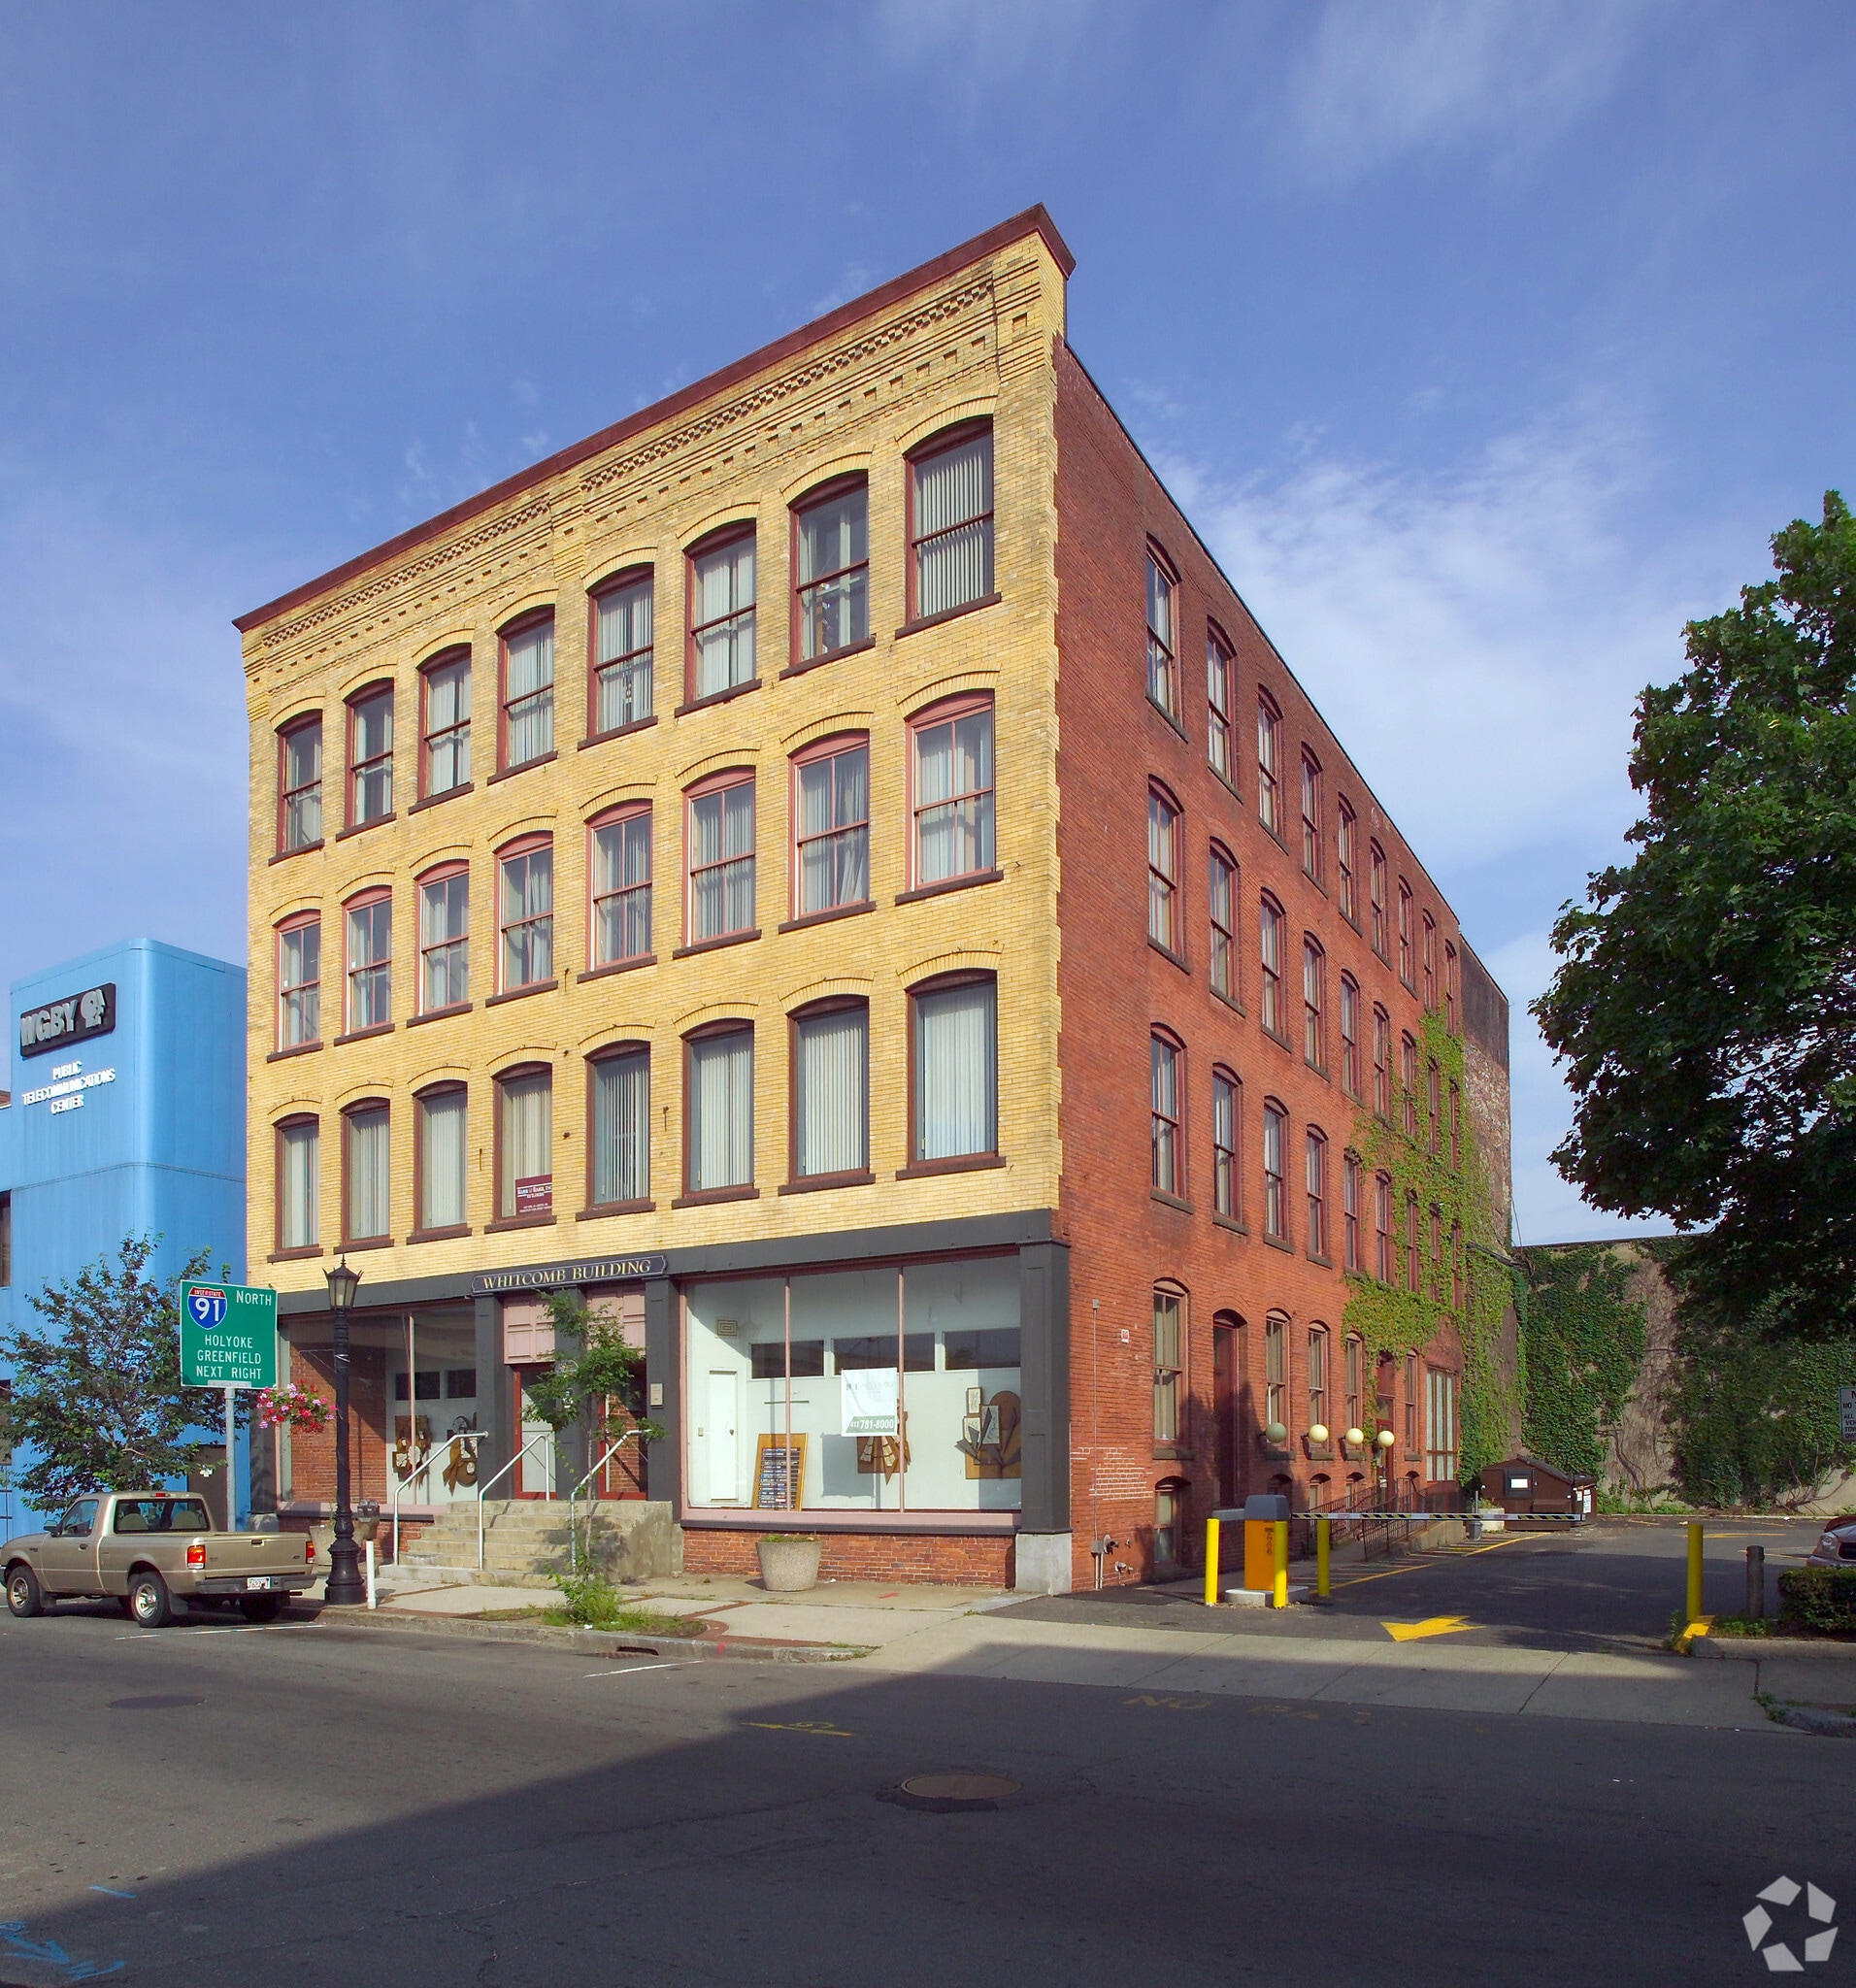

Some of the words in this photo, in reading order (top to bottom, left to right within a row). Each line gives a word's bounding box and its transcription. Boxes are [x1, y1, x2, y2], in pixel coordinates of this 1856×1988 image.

[20, 999, 78, 1047] WGBY
[52, 1061, 83, 1080] PUBLIC
[50, 1095, 84, 1115] CENTER
[482, 1270, 566, 1290] WHITCOMB
[572, 1259, 651, 1279] BUILDING
[236, 1290, 272, 1306] NORTH
[195, 1298, 219, 1321] 91
[205, 1335, 253, 1348] HOLYOKE
[197, 1350, 261, 1364] GREENFIELD
[196, 1366, 222, 1377] NEXT
[231, 1368, 262, 1379] RIGHT
[860, 1419, 894, 1430] 781-8000
